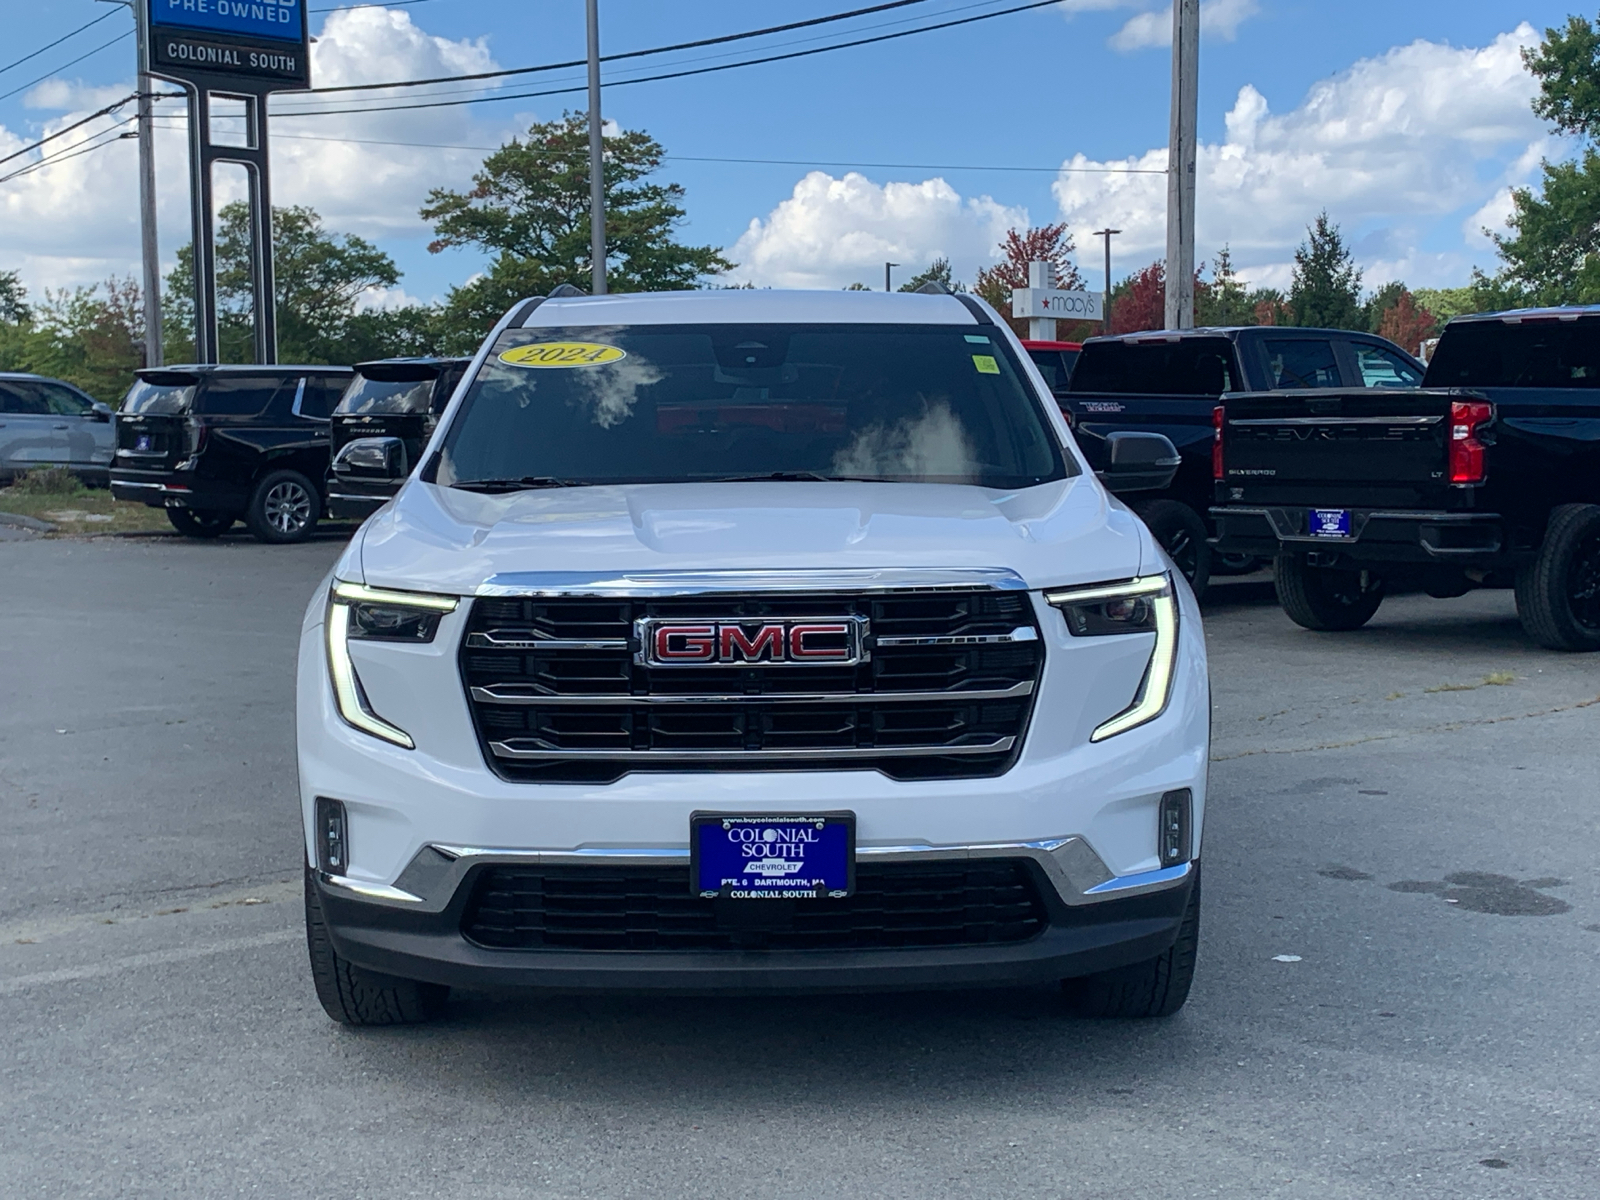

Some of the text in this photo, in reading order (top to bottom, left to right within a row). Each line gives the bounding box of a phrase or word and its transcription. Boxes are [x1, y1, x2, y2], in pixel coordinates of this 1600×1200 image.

[169, 0, 290, 23] PRE-OWNED
[167, 42, 296, 72] COLONIAL SOUTH
[1052, 294, 1095, 317] macy's
[516, 347, 608, 363] 2024
[655, 624, 849, 661] GMC
[727, 828, 820, 843] COLONIAL
[741, 843, 805, 858] SOUTH
[749, 863, 797, 871] CHEVROLET
[754, 878, 810, 888] DARTMOUTH,
[730, 890, 817, 899] COLONIAL SOUTH
